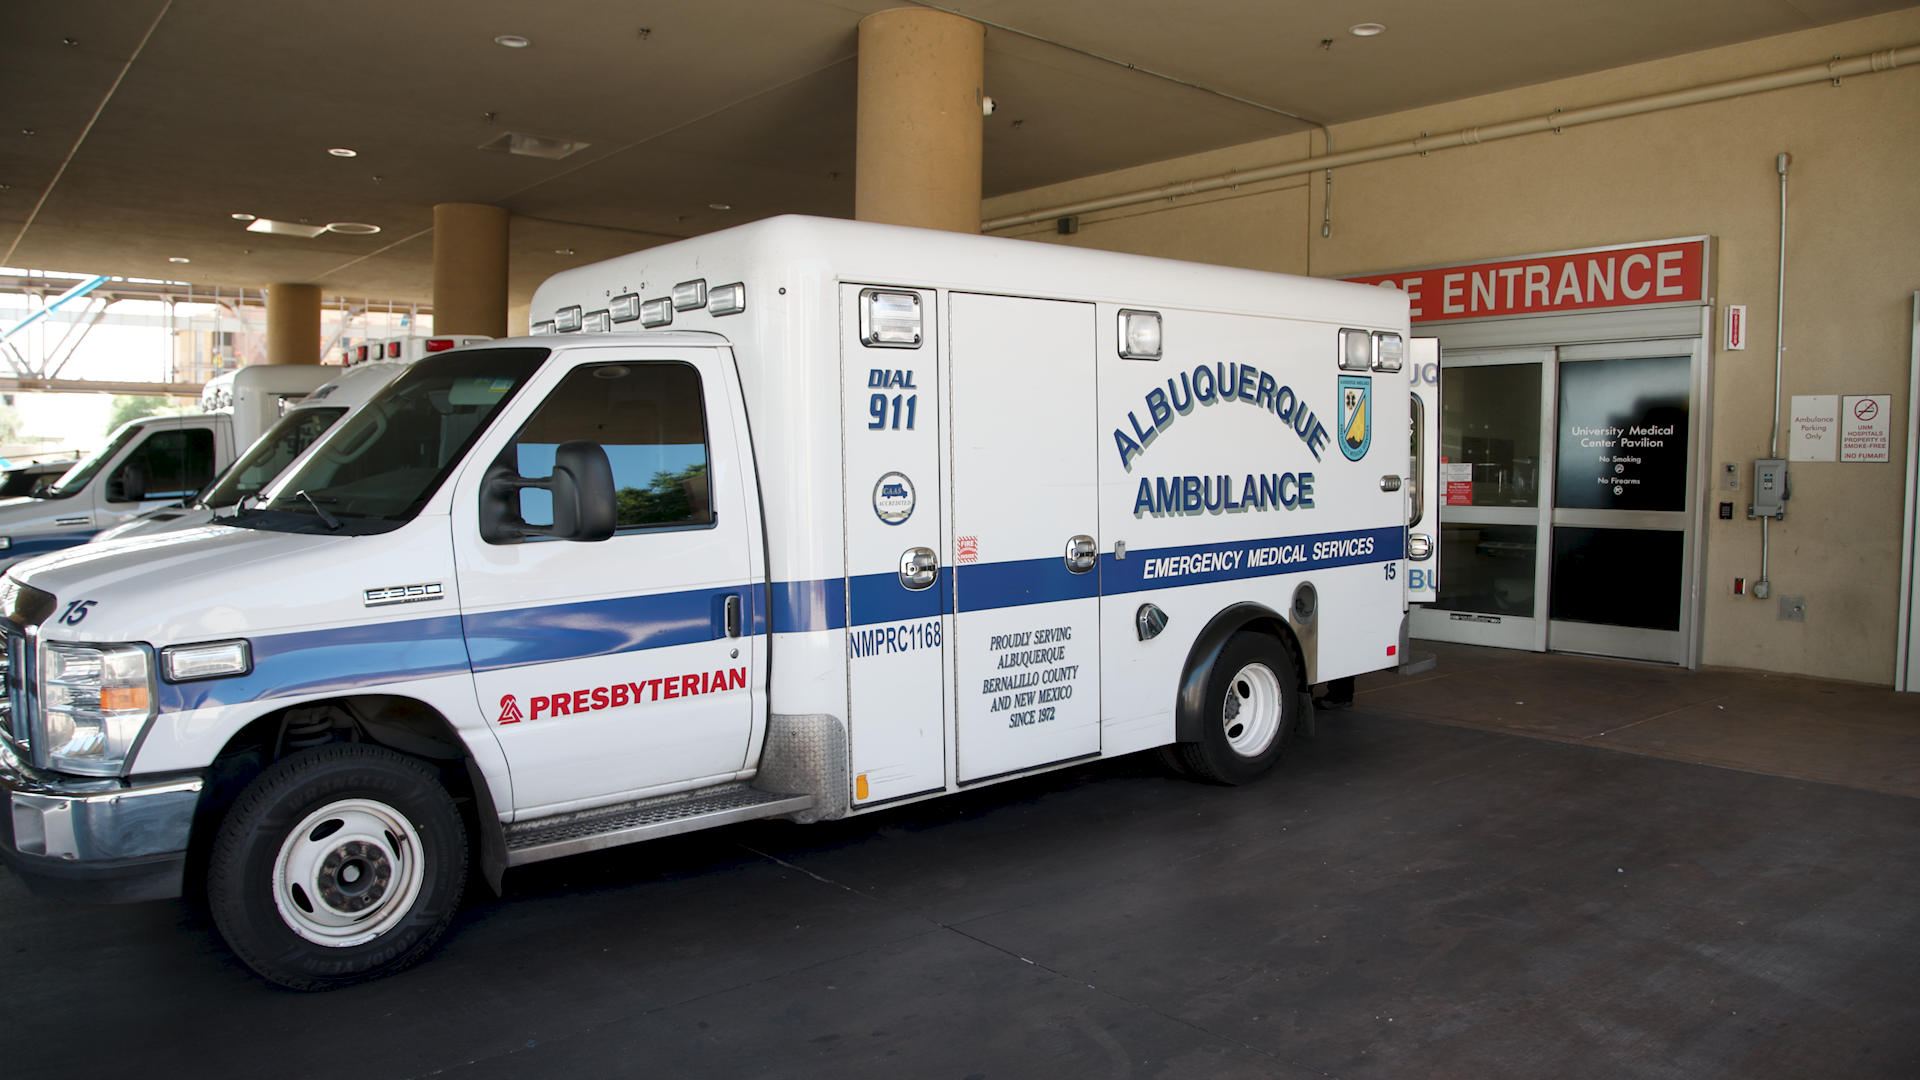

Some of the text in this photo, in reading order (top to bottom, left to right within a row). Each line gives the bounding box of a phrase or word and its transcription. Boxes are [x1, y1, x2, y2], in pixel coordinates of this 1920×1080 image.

[1443, 250, 1684, 315] ENTRANCE
[868, 369, 917, 390] DIAL
[868, 393, 917, 431] 911
[1113, 362, 1331, 474] ALBUQUERQUE
[1571, 425, 1674, 438] University Medical
[1581, 436, 1664, 448] Center Pavilion
[1801, 425, 1827, 433] Parking
[1612, 455, 1642, 464] Smoking
[883, 487, 902, 495] CAAS
[1133, 472, 1315, 519] AMBULANCE
[1142, 536, 1375, 580] EMERGENCY MEDICAL SERVICES
[1383, 562, 1397, 581] 15
[365, 583, 443, 601] E-350
[58, 600, 98, 627] 15
[850, 621, 941, 659] NMPRC1168
[990, 626, 1072, 651] PROUDLY SERVING
[997, 646, 1065, 669] ALBUQUERQUE
[982, 665, 1079, 694] BERNALILLO COUNTY
[530, 667, 747, 721] PRESBYTERIAN
[990, 684, 1073, 713] AND NEW MEXICO
[1009, 706, 1056, 728] SINCE 1972
[287, 774, 397, 812] WRANGLER
